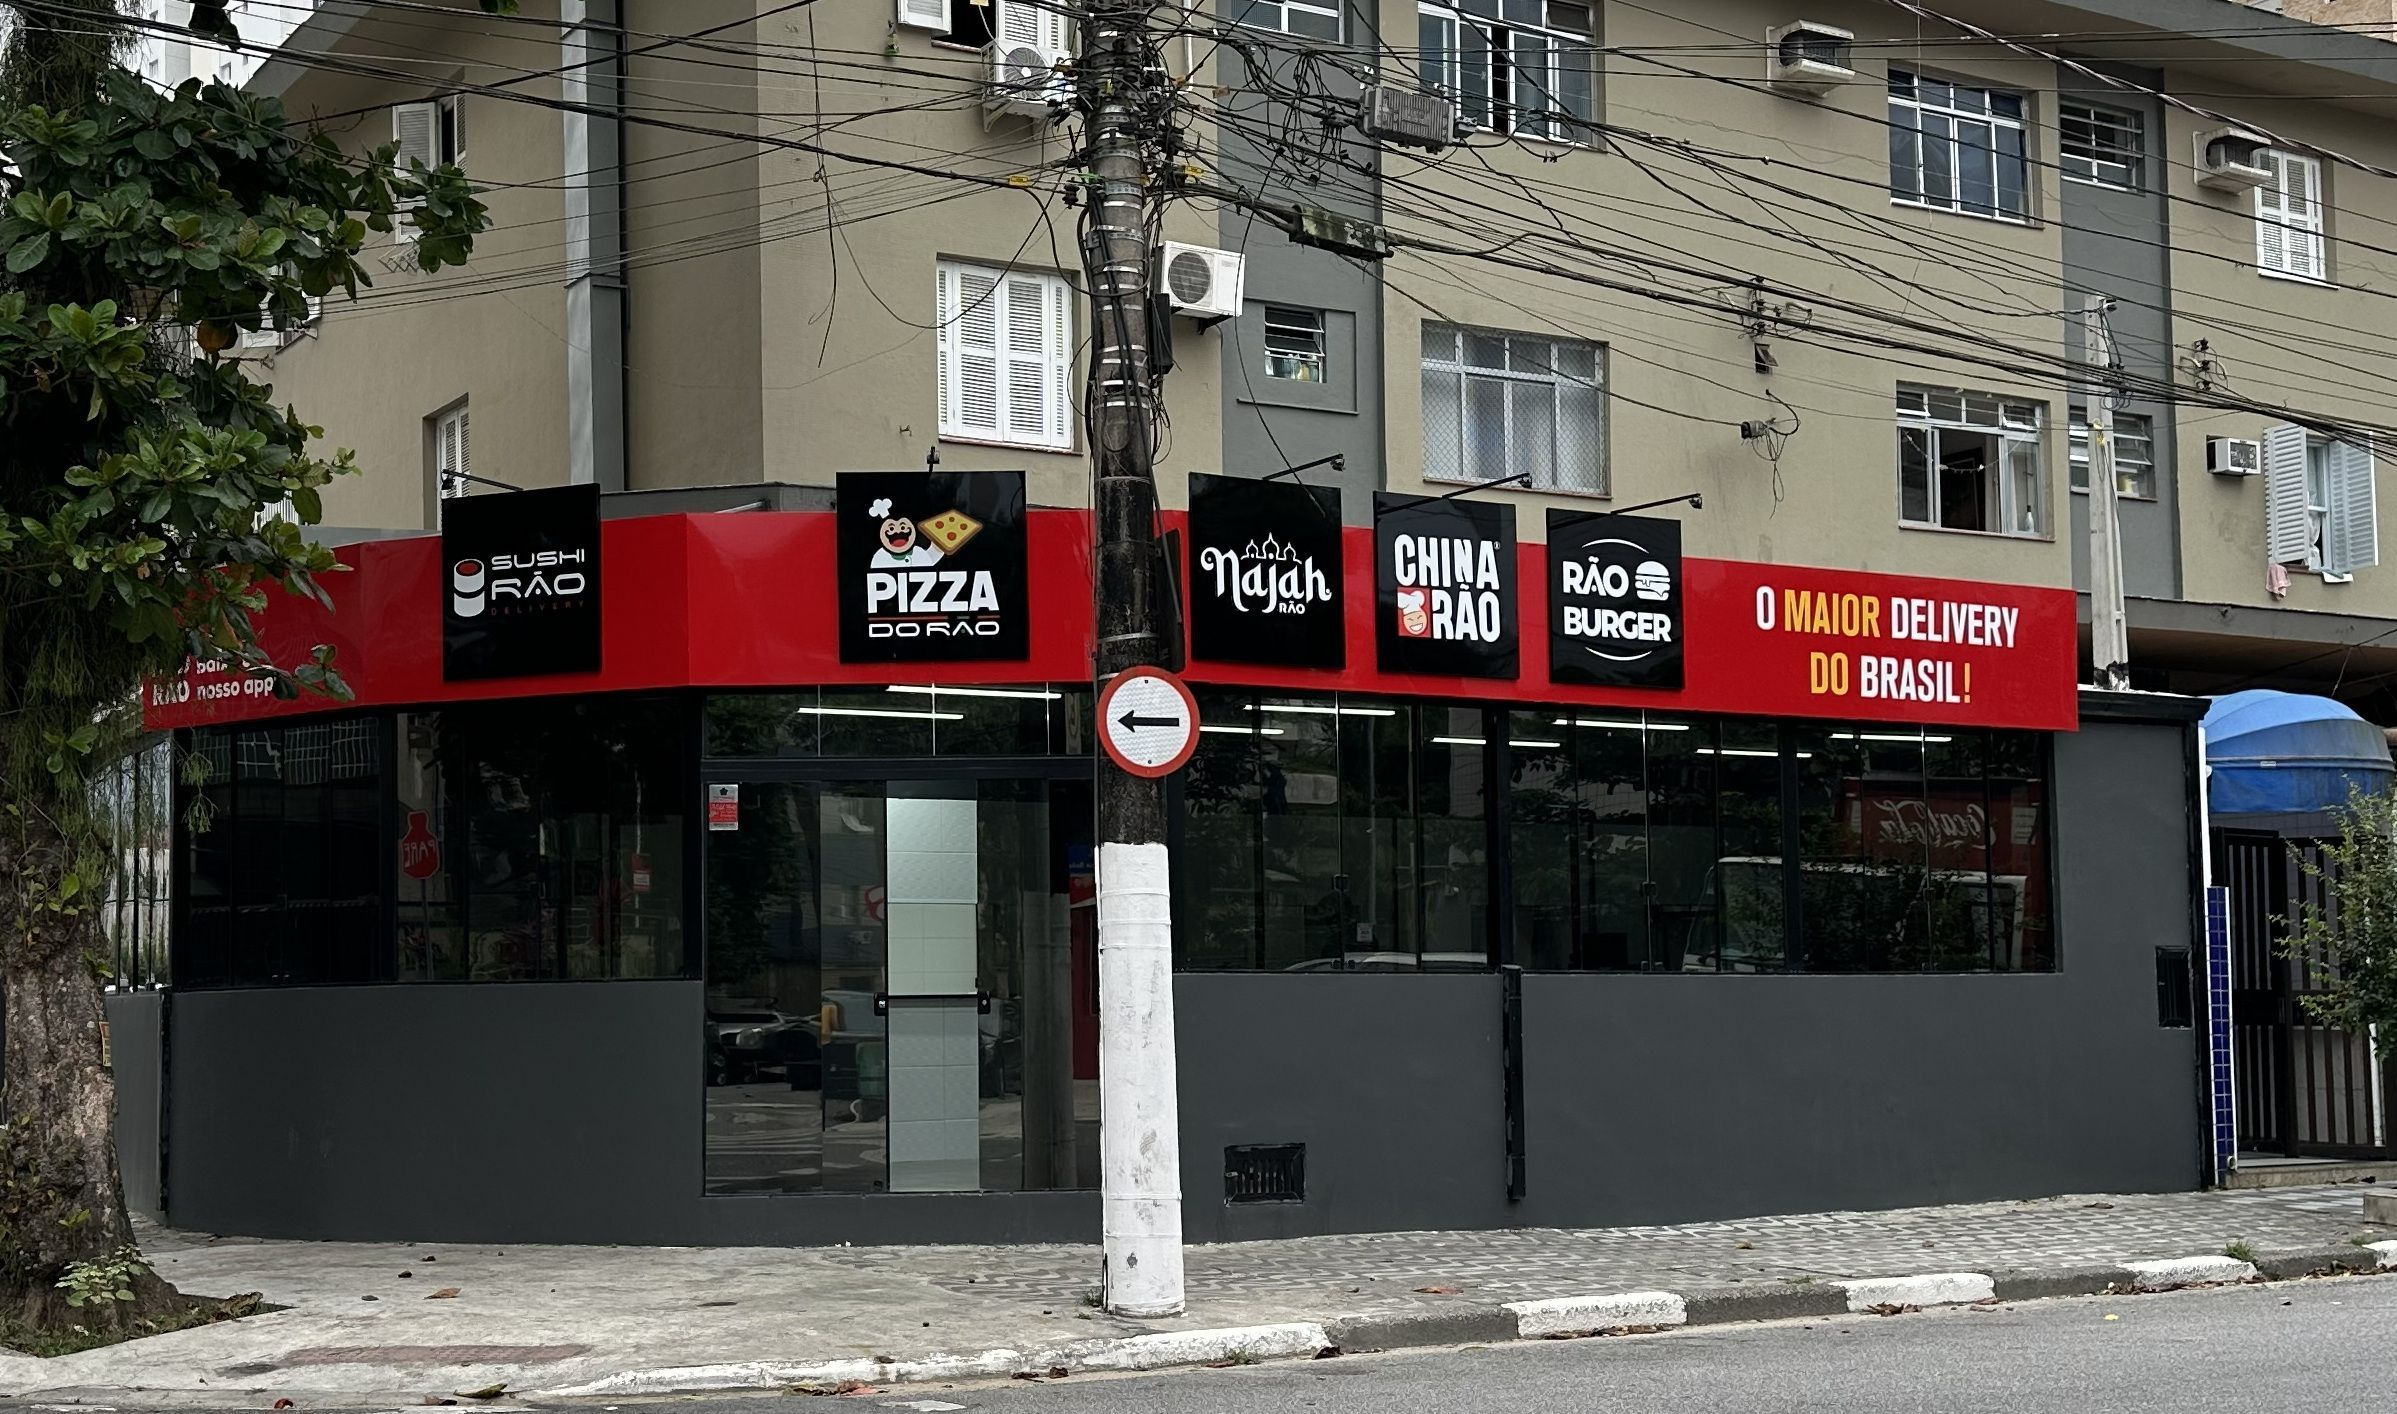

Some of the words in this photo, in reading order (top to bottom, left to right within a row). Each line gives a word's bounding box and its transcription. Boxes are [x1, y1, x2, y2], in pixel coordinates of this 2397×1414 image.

[491, 548, 585, 571] SUSHI
[491, 571, 585, 600] RÃO
[866, 570, 1000, 613] PIZZA
[1562, 556, 1629, 598] RÃO
[491, 600, 584, 616] DELIVERY
[1279, 600, 1305, 614] RÃO
[1432, 584, 1500, 643] RÃO
[1756, 585, 1775, 630] O
[1784, 589, 1880, 638] MAIOR
[1891, 597, 2019, 648] DELIVERY
[869, 622, 920, 637] DO
[1563, 606, 1672, 642] BURGER
[197, 681, 240, 700] nosso
[244, 676, 276, 698] app
[1810, 651, 1849, 696] DO
[1860, 655, 1971, 704] BRASIL!
